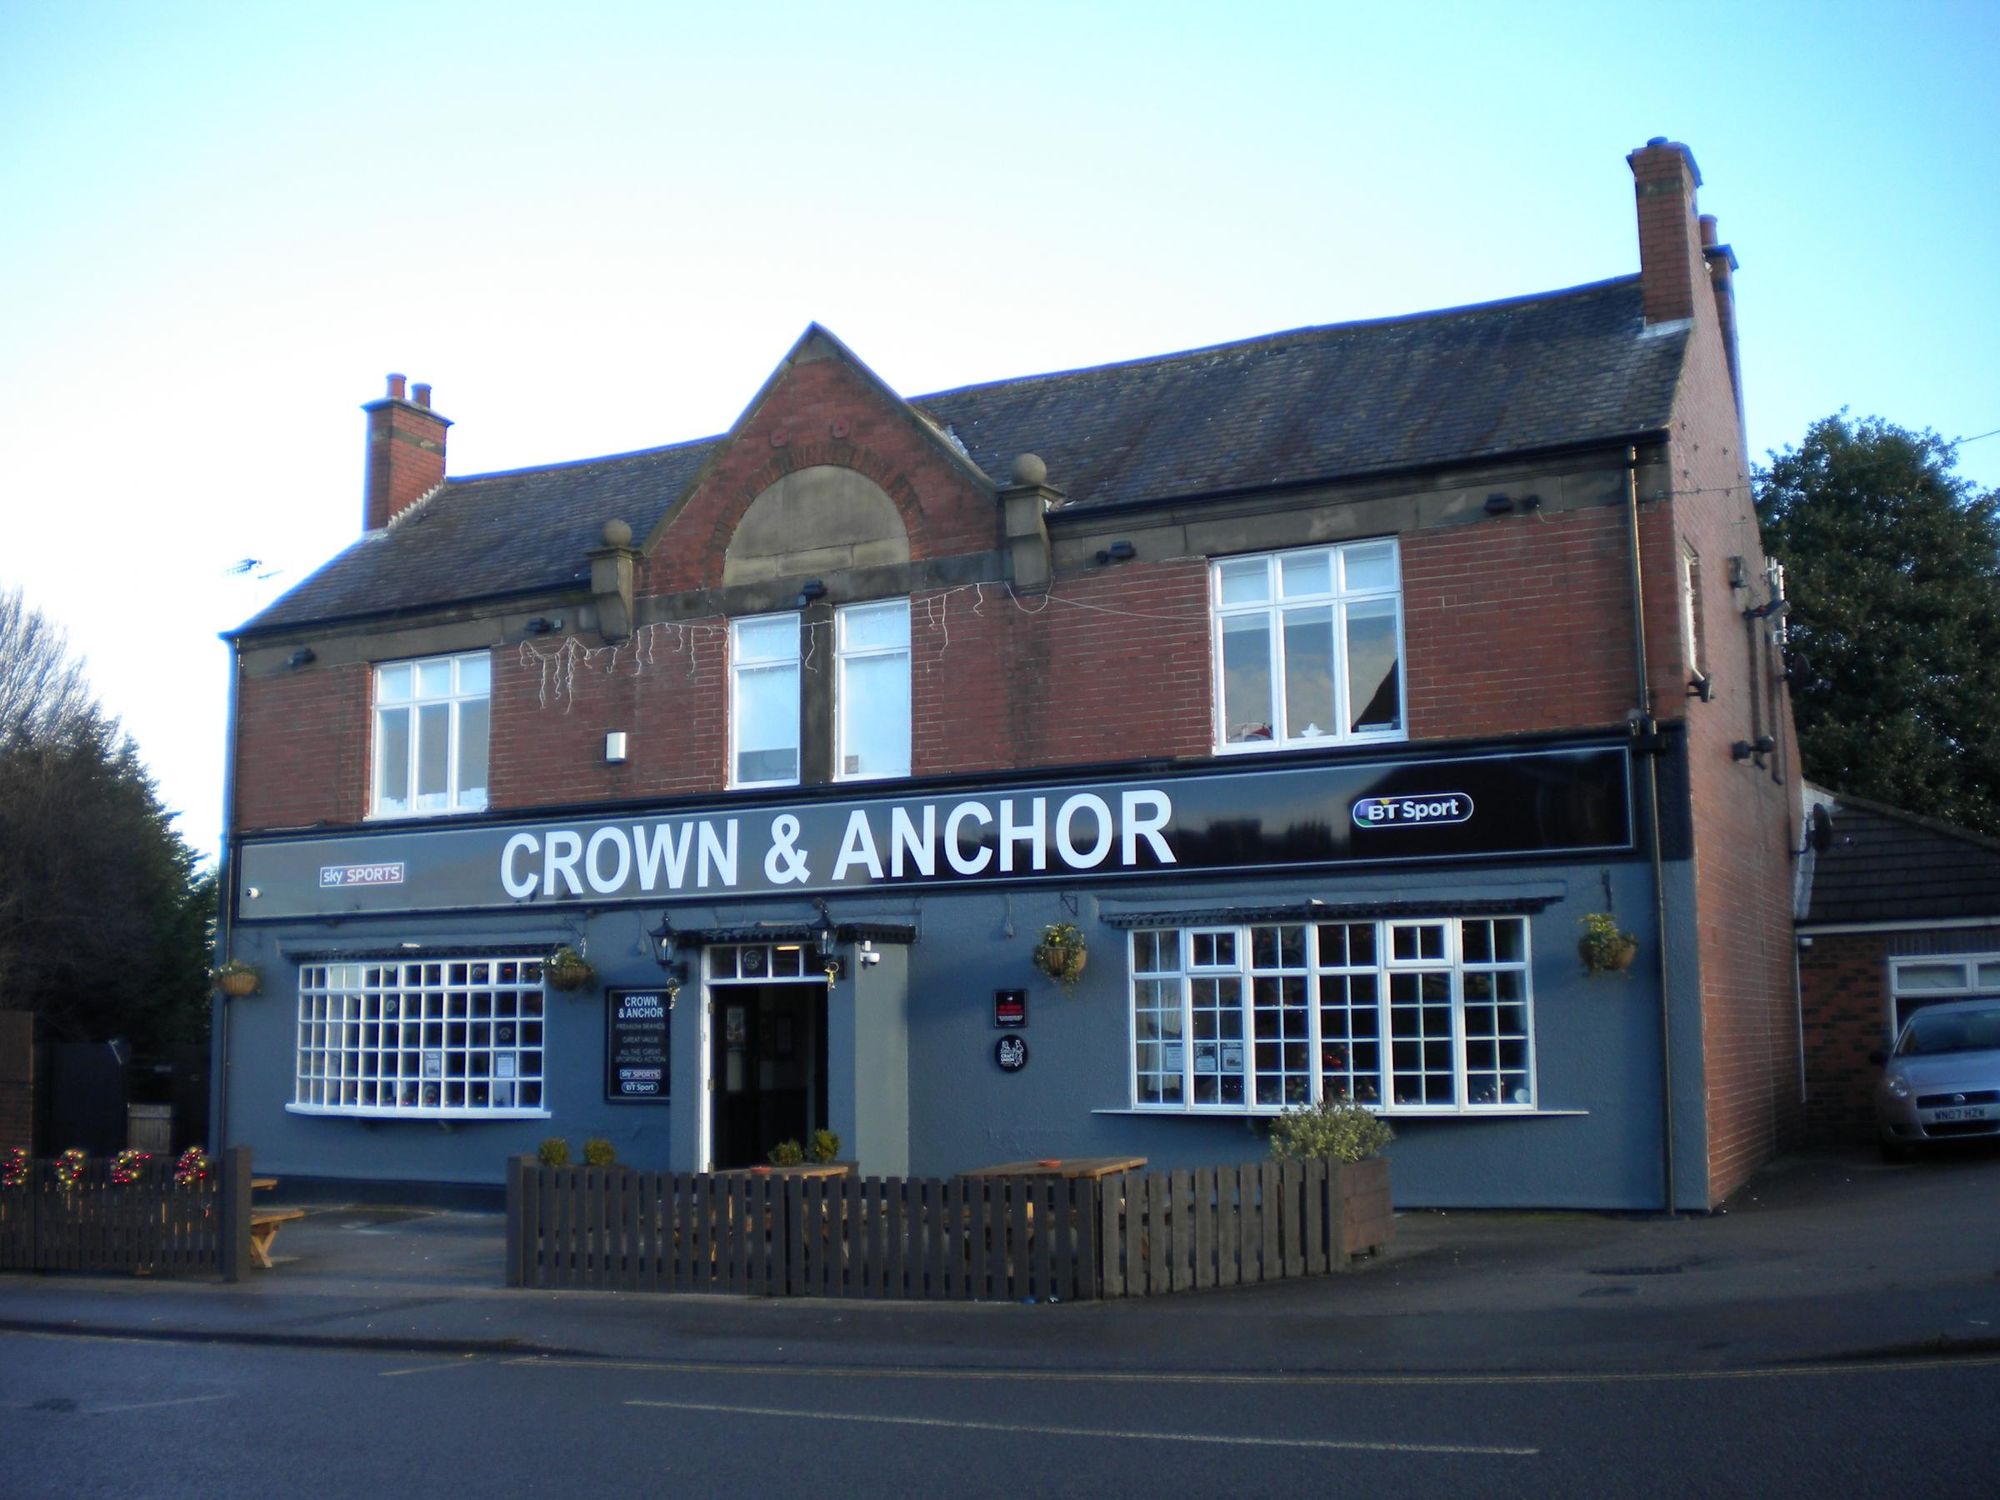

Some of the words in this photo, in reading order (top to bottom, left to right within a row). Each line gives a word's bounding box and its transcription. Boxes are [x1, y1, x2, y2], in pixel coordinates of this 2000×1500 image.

[1368, 804, 1399, 821] BT
[1402, 799, 1459, 821] Sport
[500, 819, 739, 898] CROWN
[764, 813, 811, 885] &
[832, 789, 1177, 881] ANCHOR
[323, 869, 343, 885] sky
[346, 866, 400, 883] SPORTS
[624, 996, 658, 1007] CROWN
[618, 1008, 625, 1018] &
[626, 1007, 664, 1018] ANCHOR
[633, 1070, 660, 1079] SPORTS
[636, 1083, 654, 1092] Sport
